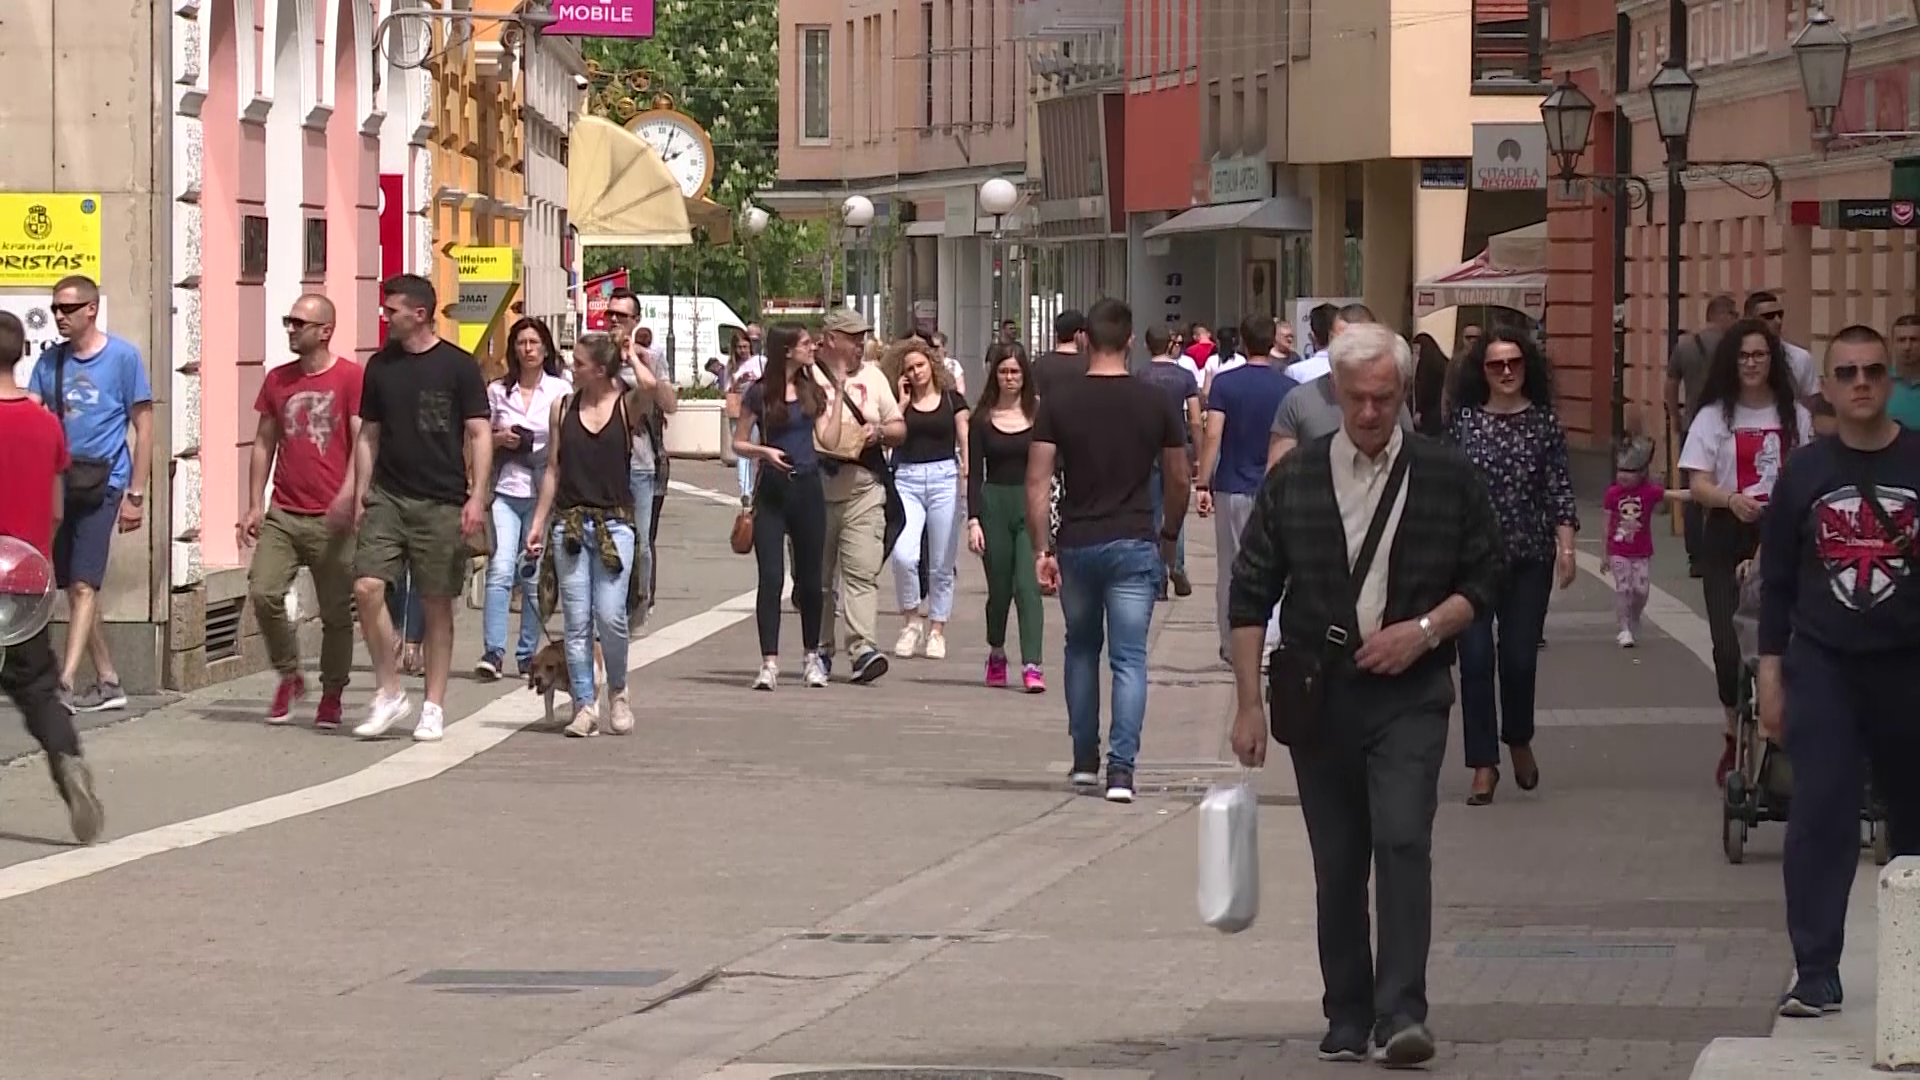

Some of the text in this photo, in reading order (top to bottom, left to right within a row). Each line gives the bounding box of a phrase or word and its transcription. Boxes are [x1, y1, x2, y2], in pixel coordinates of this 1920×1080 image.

[559, 4, 633, 22] MOBILE
[1478, 167, 1540, 179] CITADELA
[1481, 178, 1538, 188] RESTORAN
[1846, 207, 1888, 217] SPORT
